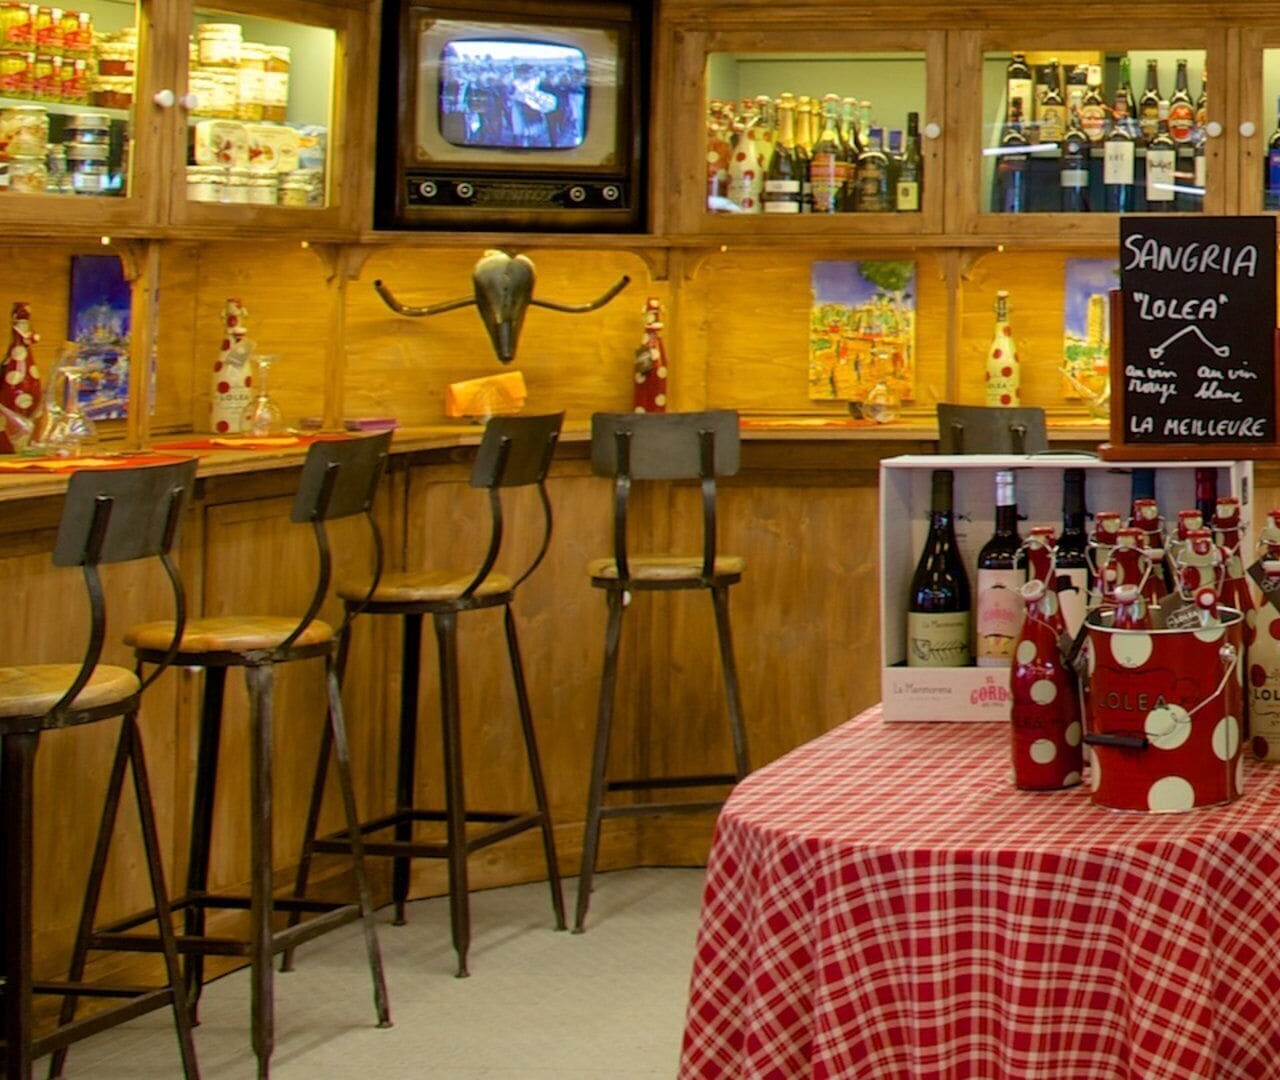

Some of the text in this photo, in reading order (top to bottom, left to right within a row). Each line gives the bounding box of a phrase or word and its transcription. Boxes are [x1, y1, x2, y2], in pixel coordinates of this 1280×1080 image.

[1124, 234, 1258, 277] SANGRIA
[1147, 361, 1178, 379] vin
[1228, 361, 1257, 380] vin
[1131, 416, 1266, 437] LA MEILLEURE
